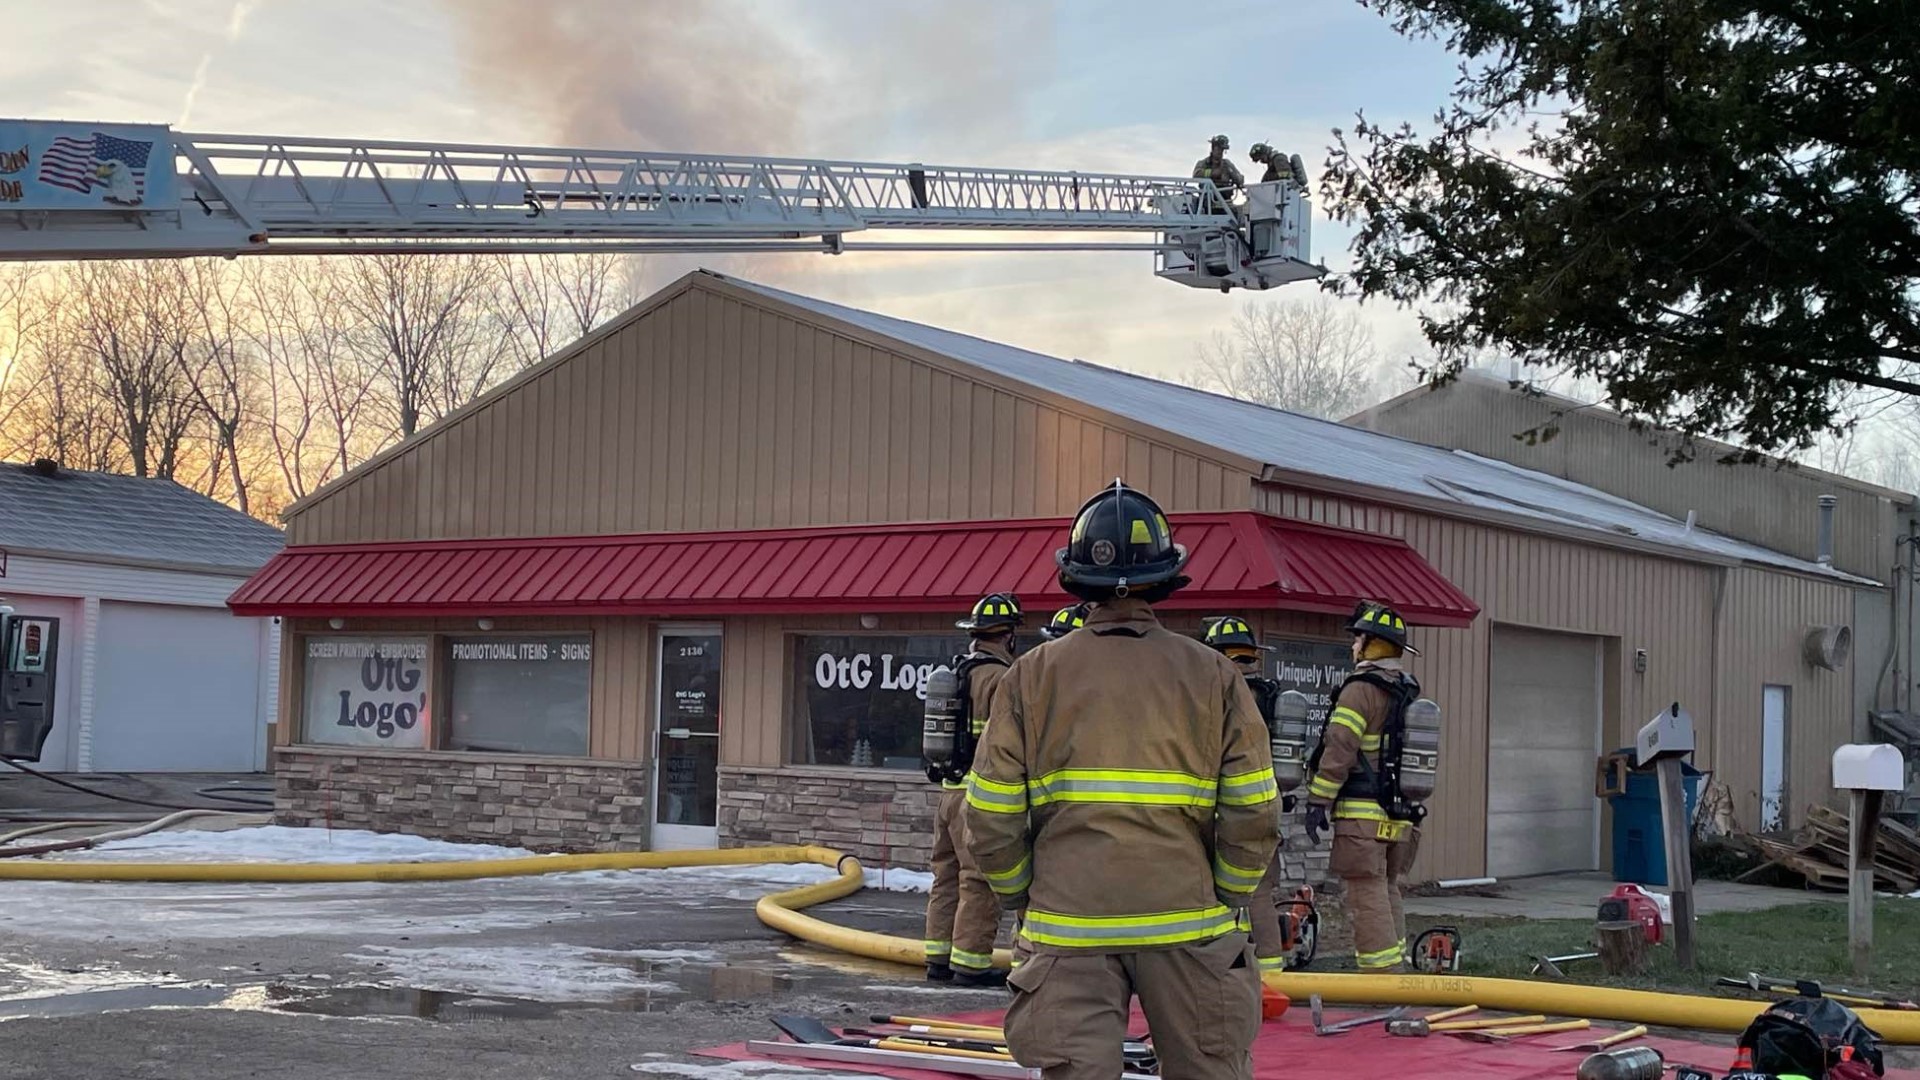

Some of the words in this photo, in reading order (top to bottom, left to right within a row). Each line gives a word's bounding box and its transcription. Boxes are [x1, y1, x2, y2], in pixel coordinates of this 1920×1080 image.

[309, 643, 338, 658] SCREEN
[339, 643, 375, 658] PRINTING
[452, 643, 518, 660] PROMOTIONAL
[519, 643, 548, 660] ITEMS
[561, 644, 590, 661] SIGNS
[361, 650, 421, 692] OtG
[815, 653, 873, 690] OtG
[880, 654, 950, 700] Log
[1276, 661, 1322, 688] Uniquely
